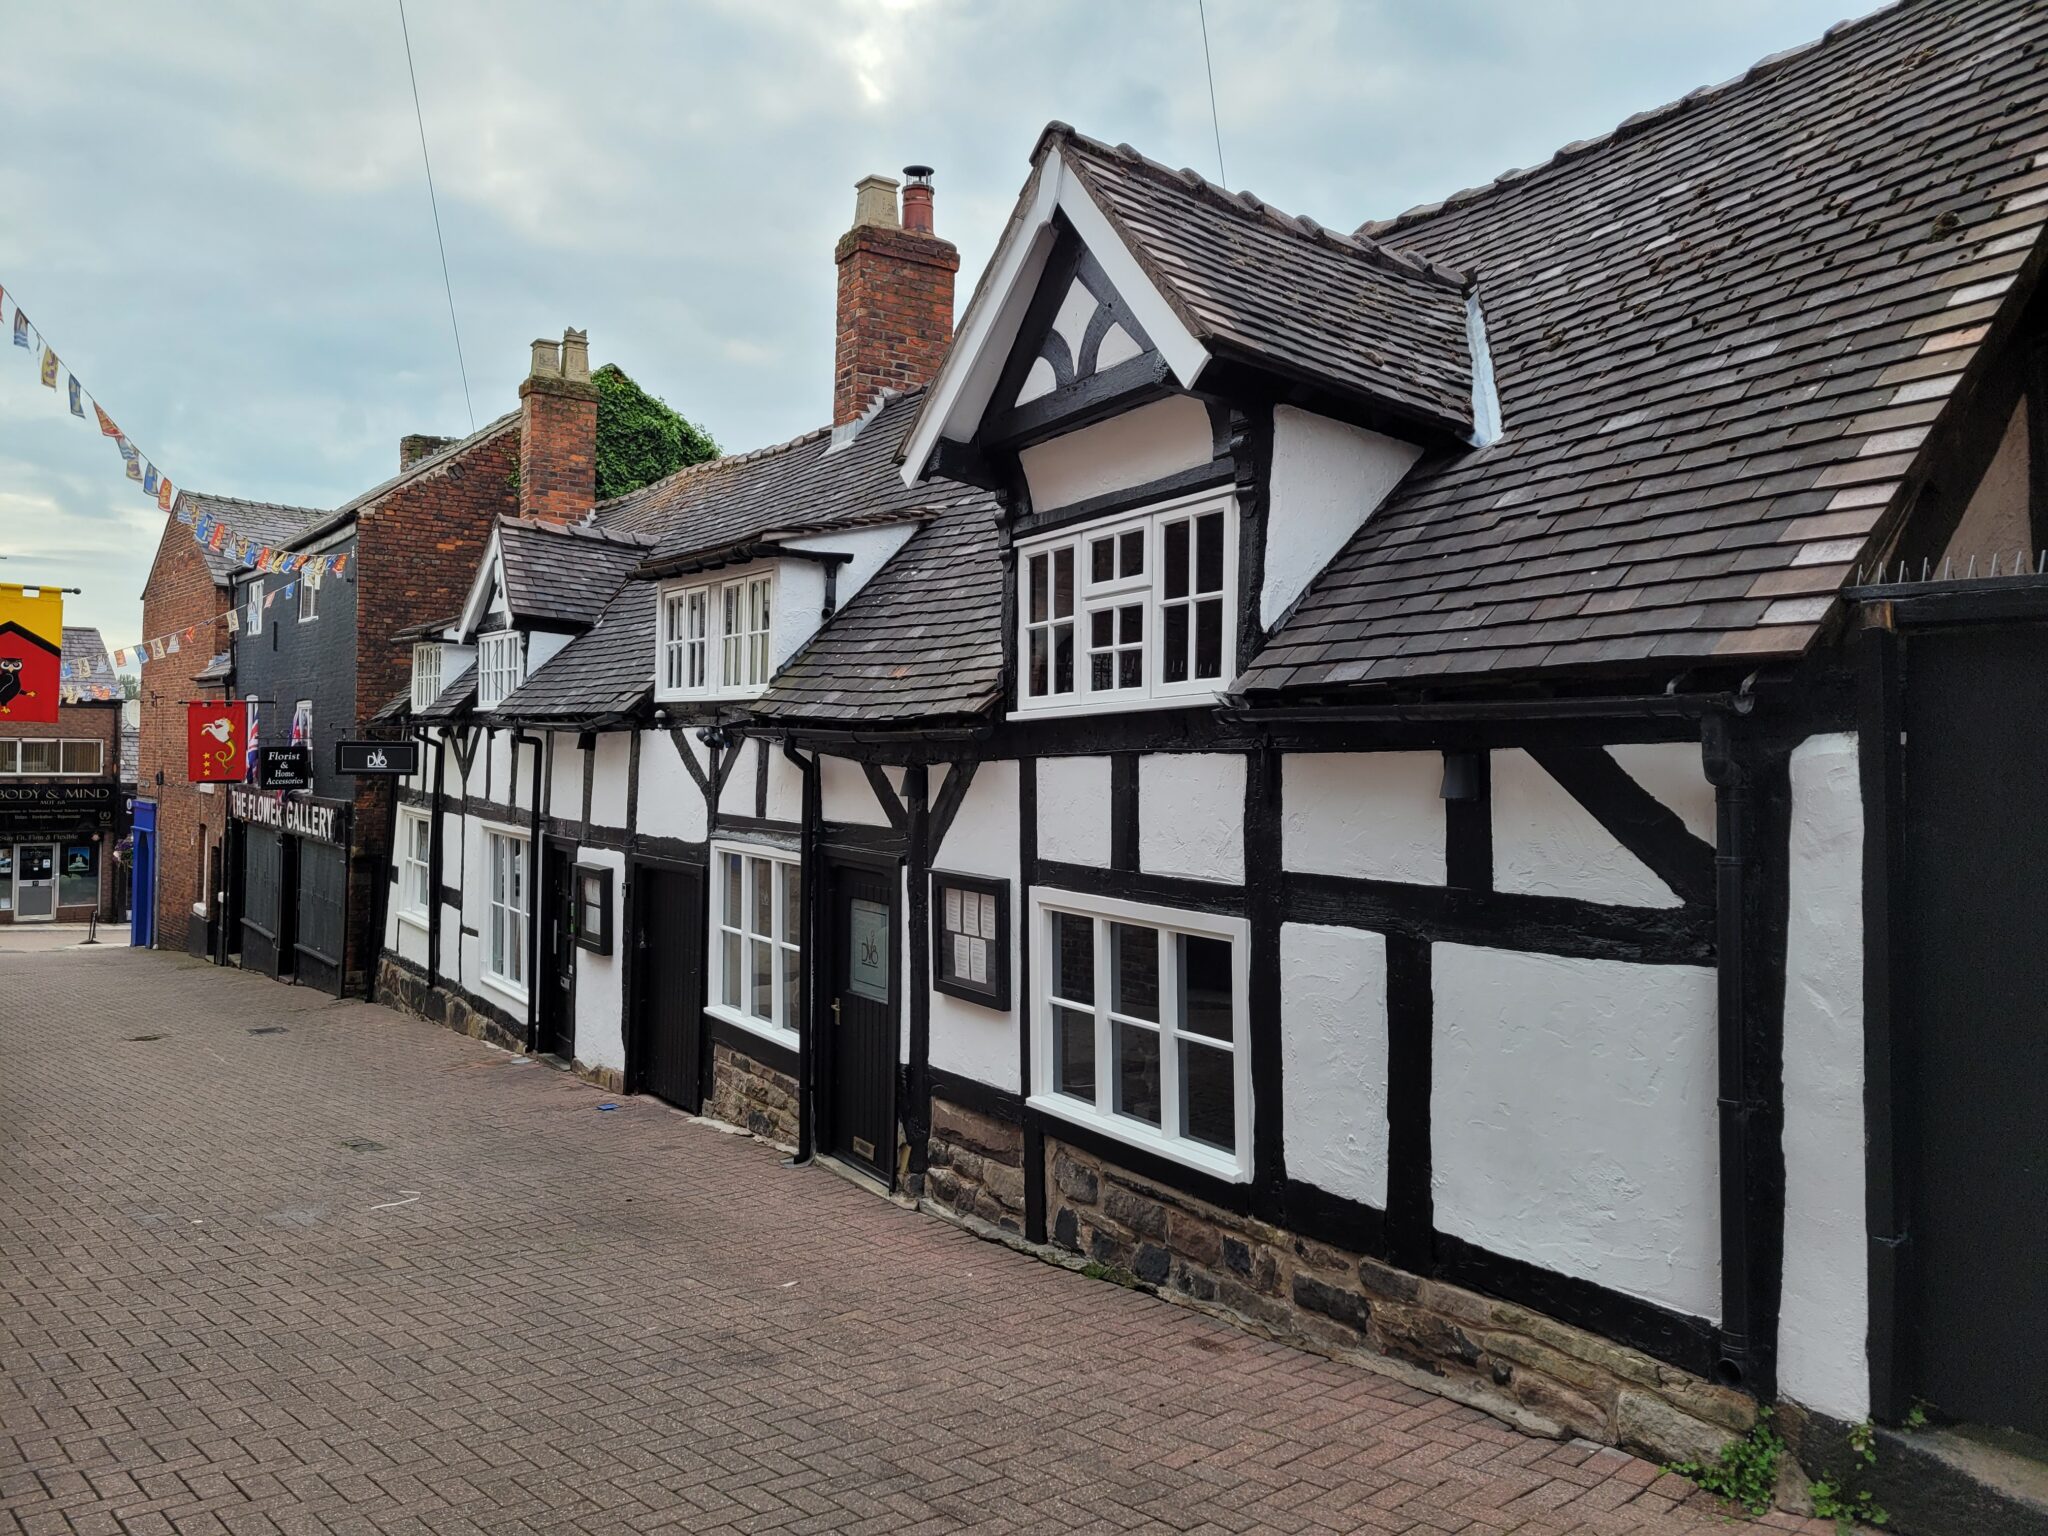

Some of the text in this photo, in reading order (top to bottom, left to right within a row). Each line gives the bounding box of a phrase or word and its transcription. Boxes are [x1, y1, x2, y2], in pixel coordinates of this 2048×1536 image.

[268, 751, 300, 760] Florist
[280, 761, 289, 769] &
[274, 769, 295, 777] Home
[266, 777, 304, 785] Accessories
[45, 789, 60, 799] &
[65, 788, 110, 799] MIND
[231, 790, 334, 840] THE FLOWER GALLERY
